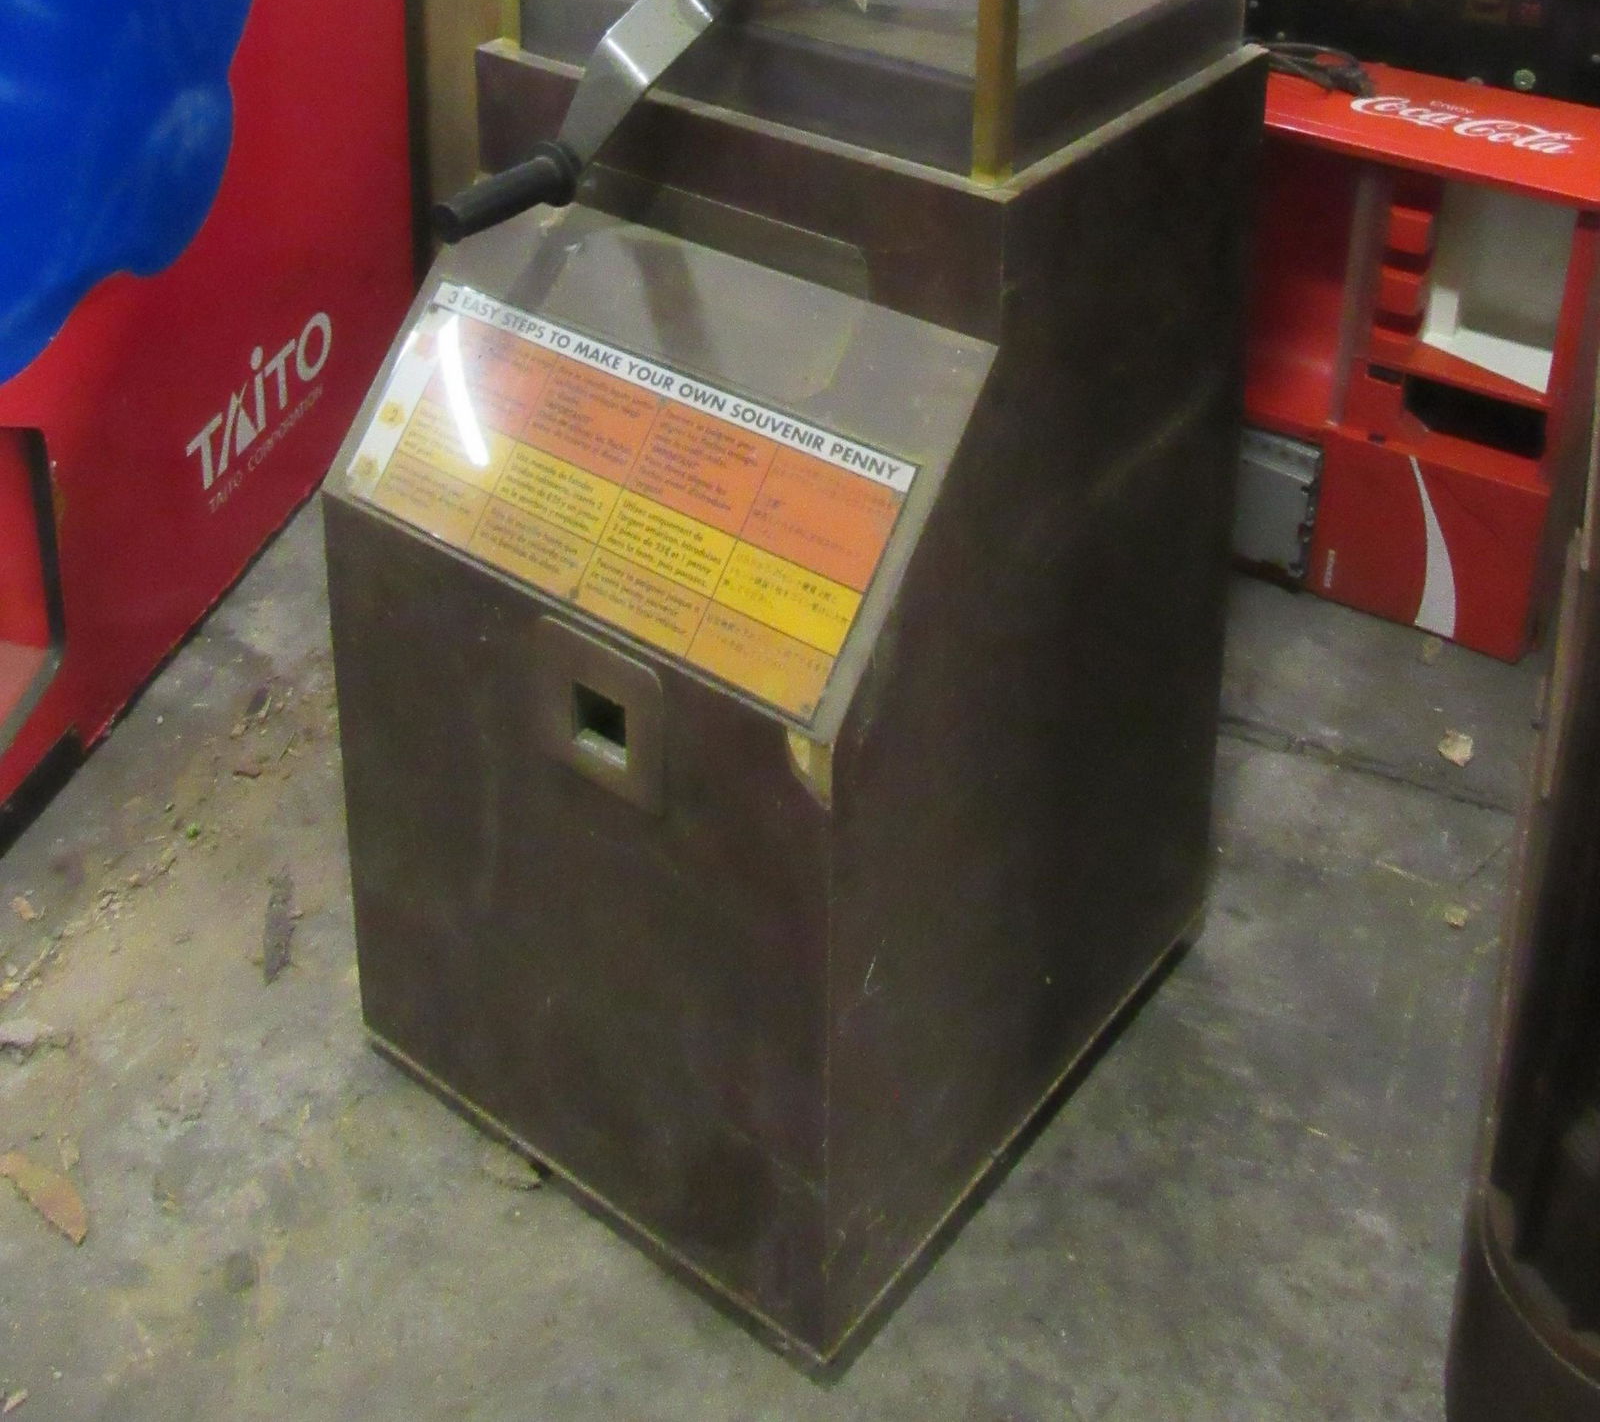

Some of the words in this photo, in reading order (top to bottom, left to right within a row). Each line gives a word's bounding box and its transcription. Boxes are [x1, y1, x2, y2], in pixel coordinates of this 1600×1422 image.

[1350, 96, 1584, 155] Coca-Cola
[447, 291, 459, 305] 3
[460, 296, 499, 321] EASY
[499, 312, 546, 340] STEPS
[547, 331, 572, 350] TO
[572, 340, 622, 370] MAKE
[624, 361, 674, 391] YOUR
[676, 381, 727, 412] OWN
[729, 402, 826, 451] SOUVENIR
[828, 440, 900, 480] PENNY
